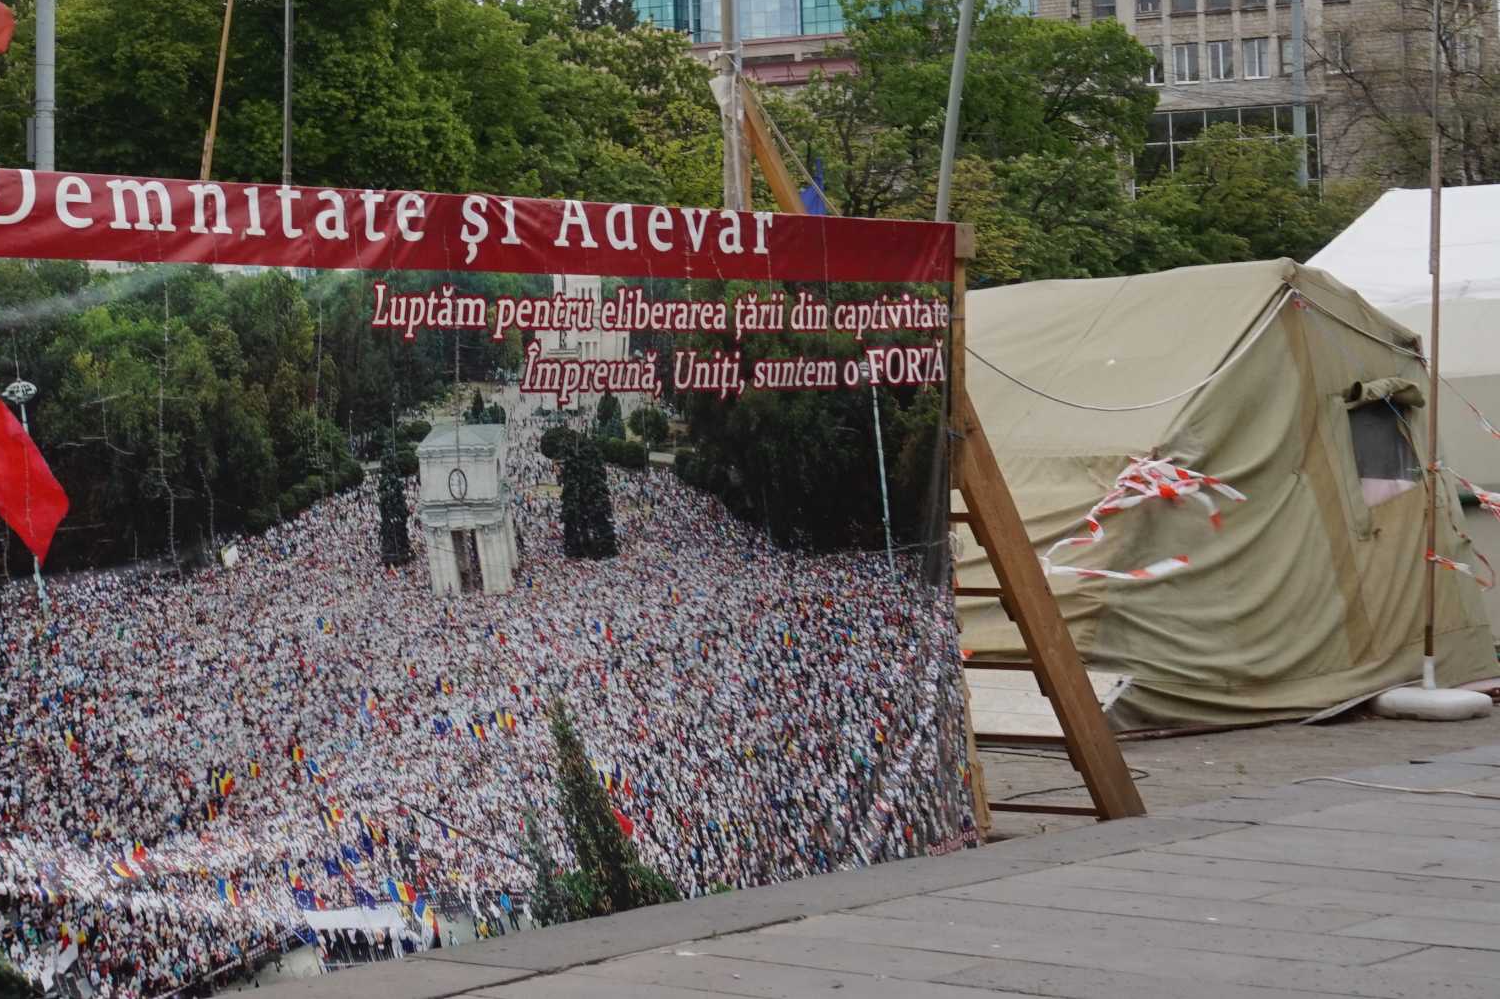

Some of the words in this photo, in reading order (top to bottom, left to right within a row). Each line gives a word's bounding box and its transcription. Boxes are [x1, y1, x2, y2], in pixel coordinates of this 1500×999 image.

[372, 284, 487, 338] Luptăm
[493, 294, 595, 339] pentru
[601, 288, 727, 330] eliberarea
[735, 294, 784, 340] țării
[790, 292, 828, 330] din
[834, 294, 949, 340] captivitate
[521, 342, 662, 402] Împreună,
[674, 351, 746, 400] Uniți,
[753, 356, 837, 388] suntem
[844, 359, 860, 386] o
